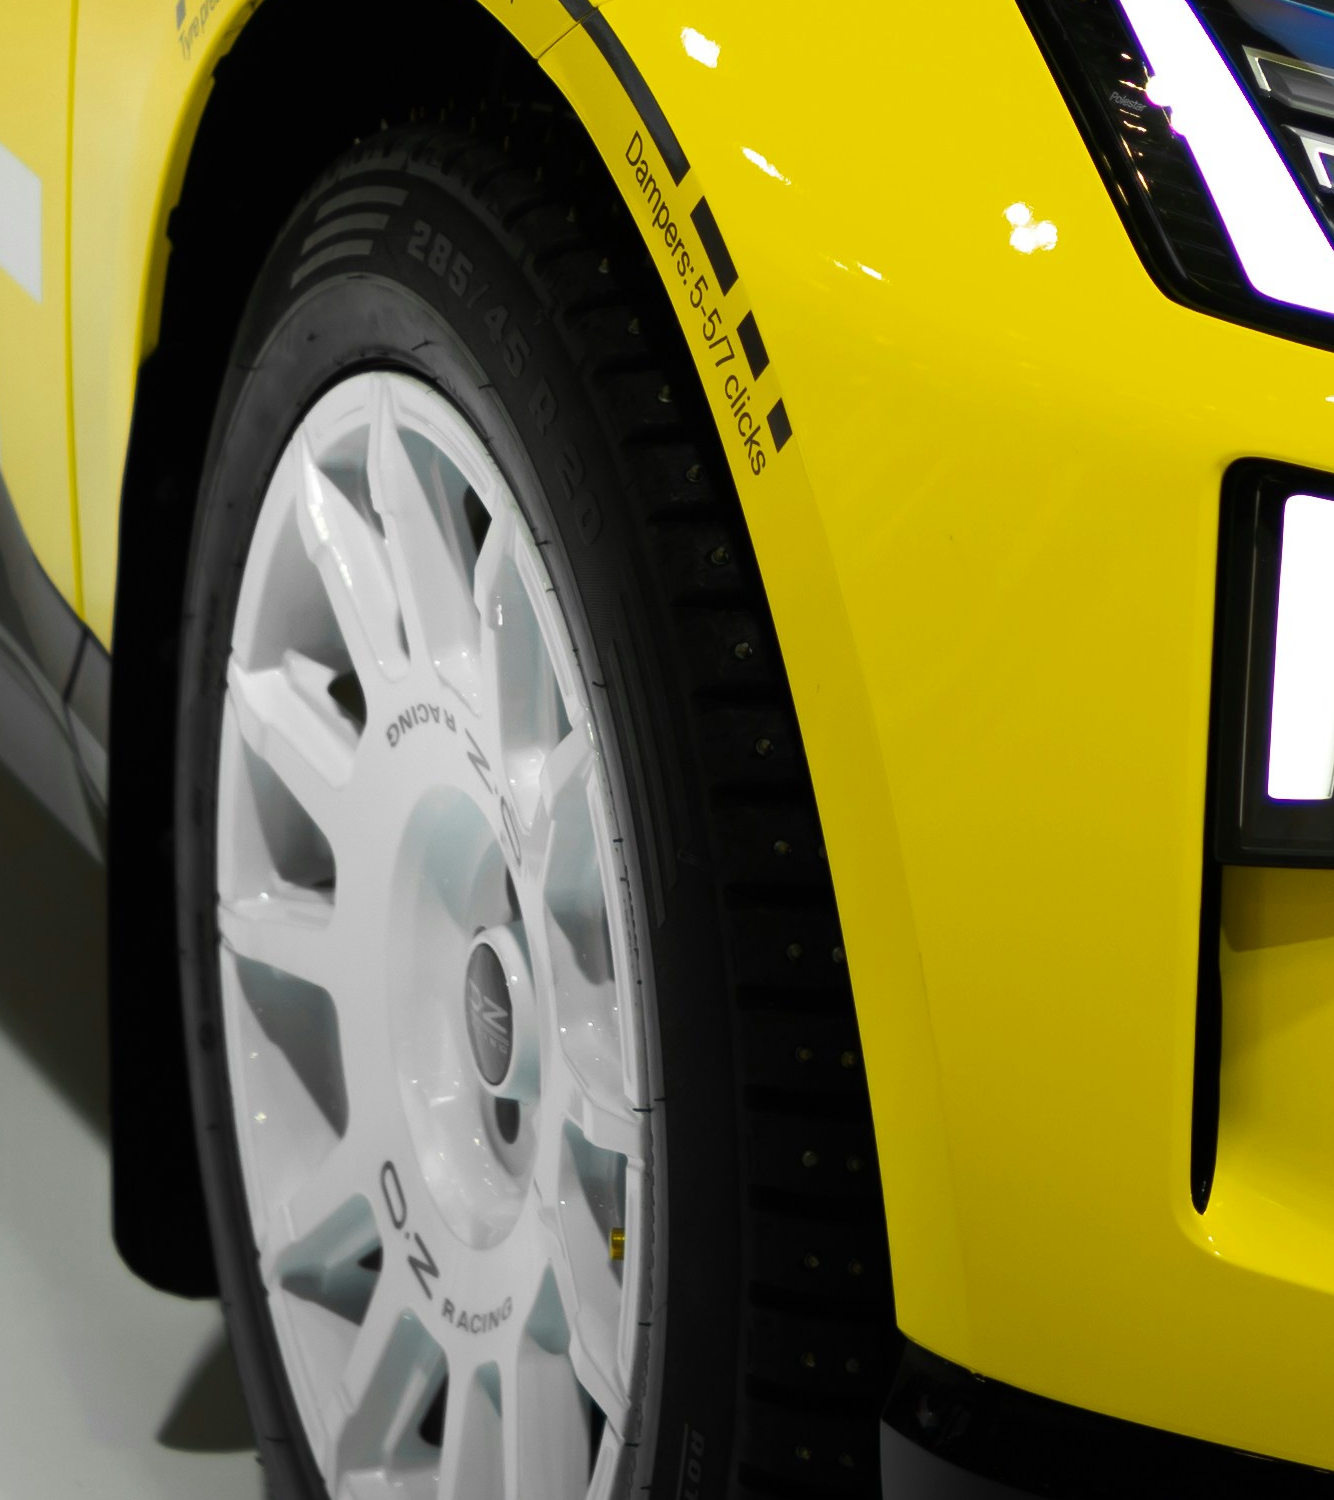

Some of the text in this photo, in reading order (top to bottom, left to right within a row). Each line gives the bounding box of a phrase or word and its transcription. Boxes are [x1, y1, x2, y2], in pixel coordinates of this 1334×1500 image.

[178, 16, 199, 61] Tyre
[1109, 91, 1147, 112] Polestar
[625, 130, 767, 477] Dampers: 5-5/7 clicks
[385, 703, 457, 748] RACING
[442, 1296, 514, 1335] RACING
